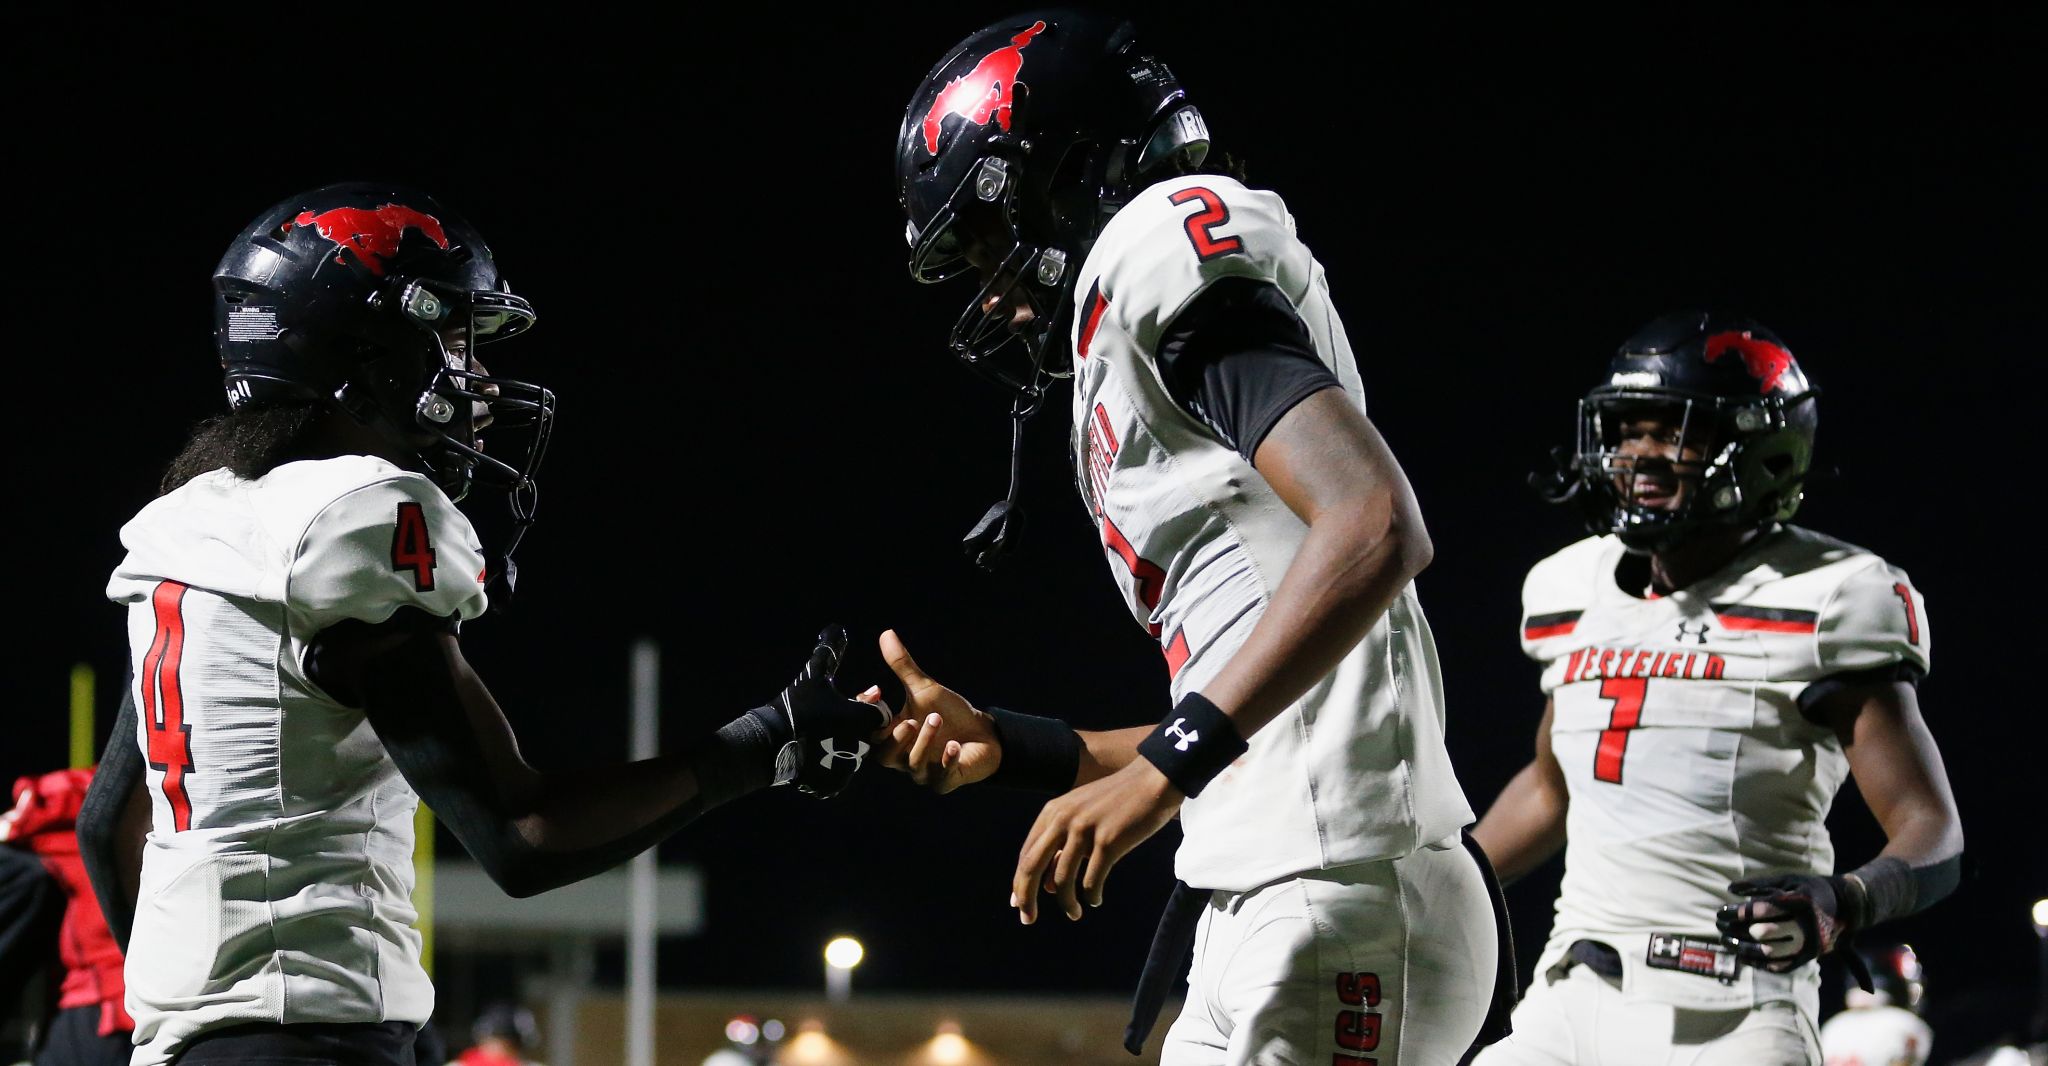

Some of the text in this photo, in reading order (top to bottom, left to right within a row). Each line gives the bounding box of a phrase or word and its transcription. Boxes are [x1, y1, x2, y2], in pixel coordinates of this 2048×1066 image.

[1168, 186, 1245, 263] 2
[391, 501, 438, 592] 4
[1893, 582, 1919, 646] 1
[141, 579, 196, 833] 4
[1594, 676, 1649, 785] 1
